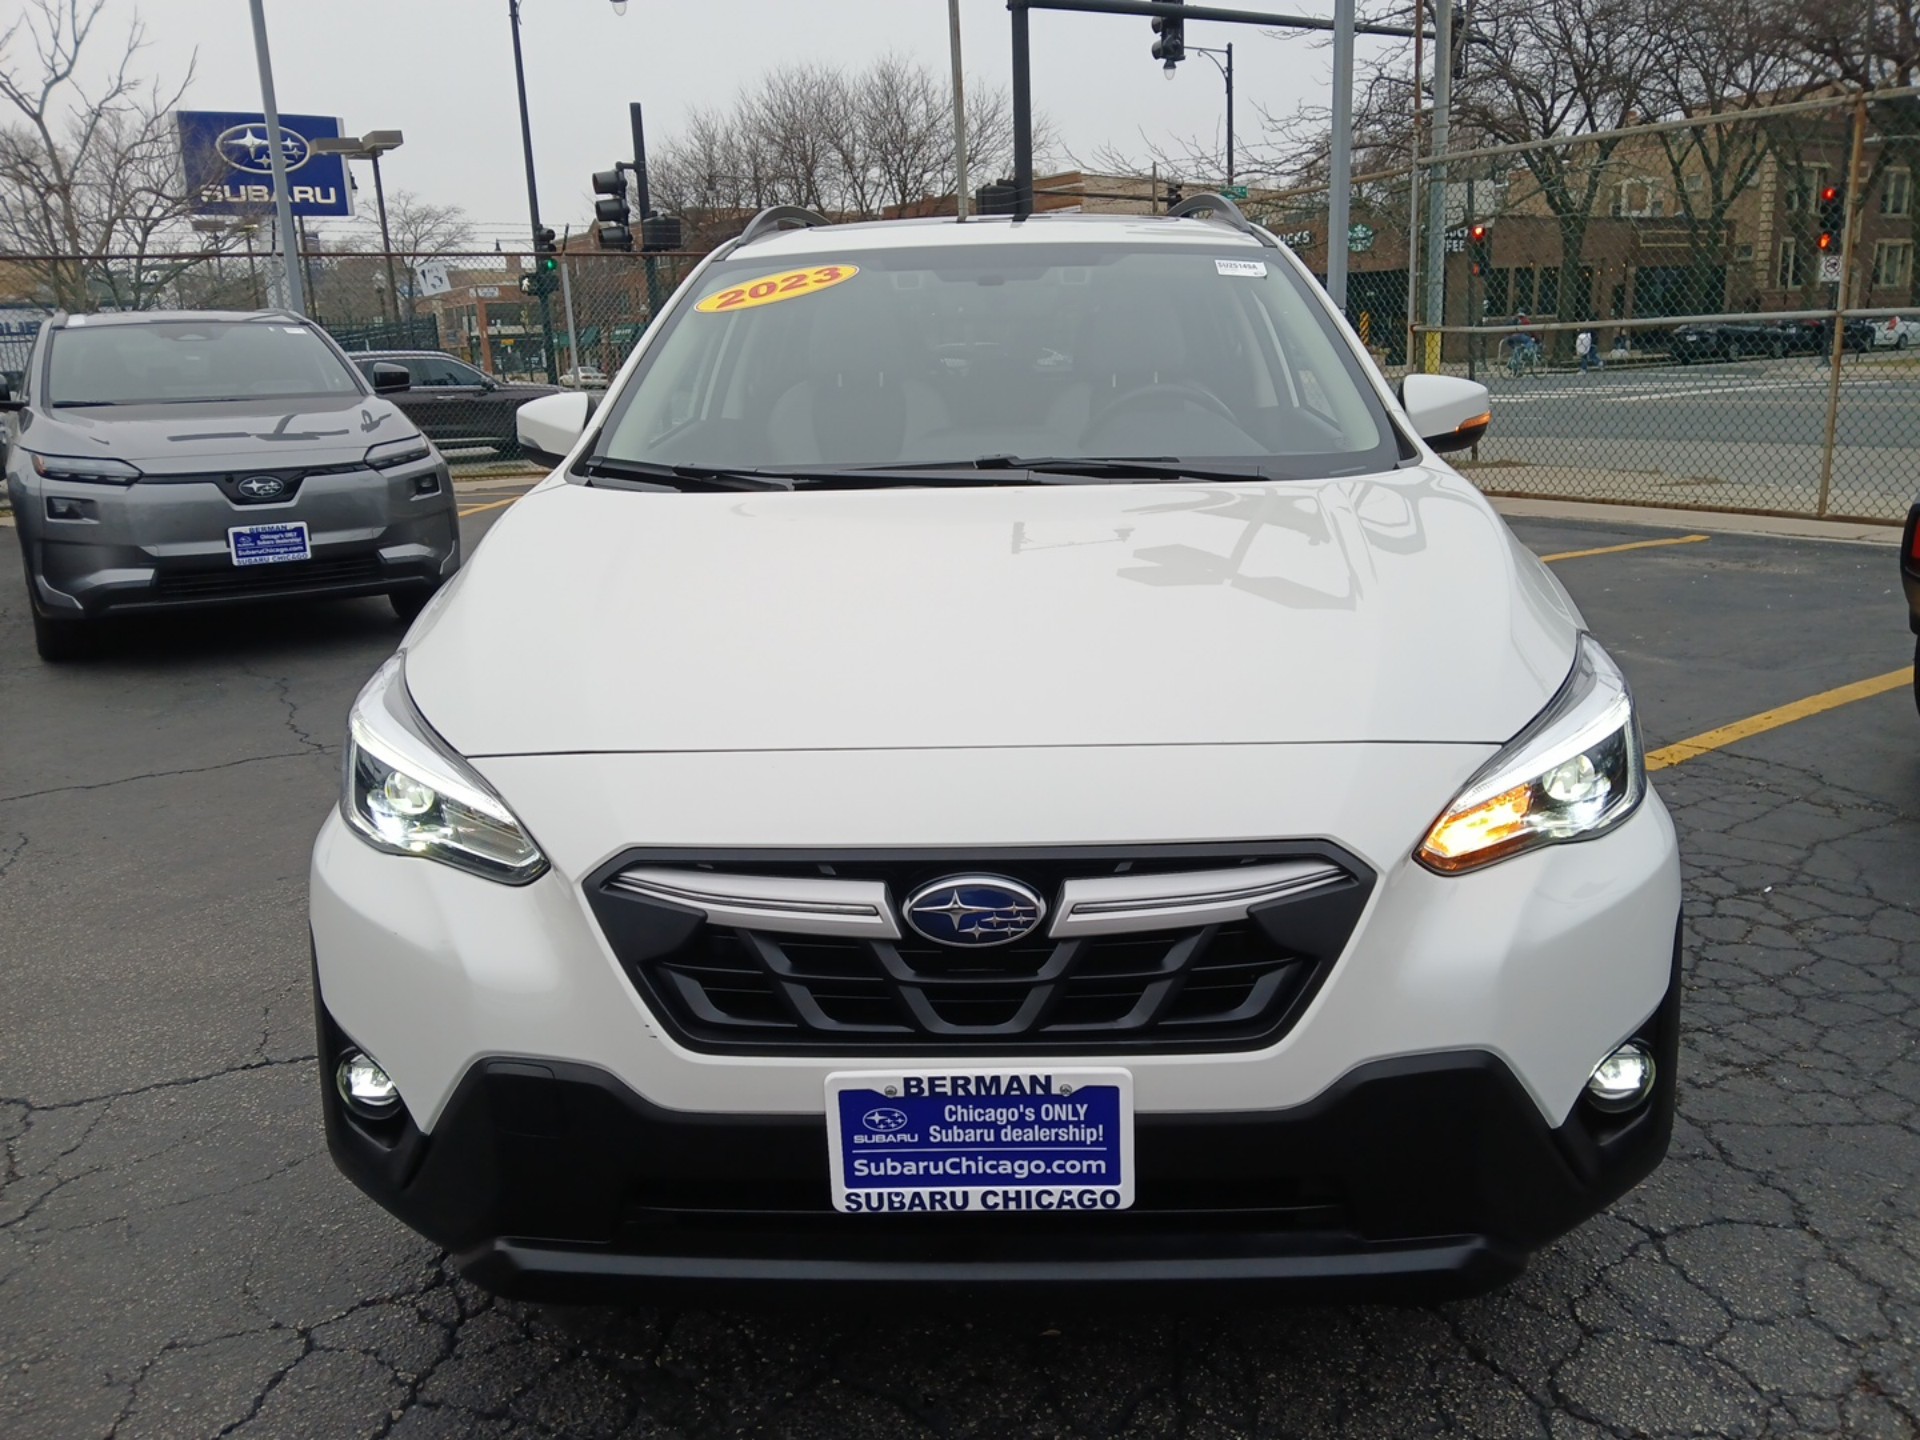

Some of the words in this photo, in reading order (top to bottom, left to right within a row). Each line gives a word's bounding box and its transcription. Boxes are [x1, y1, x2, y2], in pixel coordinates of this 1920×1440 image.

[201, 184, 336, 204] SUBRU
[716, 267, 842, 310] 2023
[249, 525, 288, 533] BERMAN
[236, 557, 270, 565] SUBARU
[271, 552, 309, 561] CHICAGO
[902, 1075, 1052, 1098] BERMAN
[944, 1103, 1035, 1125] Chicago's
[1041, 1103, 1088, 1121] ONLY
[853, 1133, 919, 1144] SUBARU
[929, 1124, 995, 1143] Subaru
[1000, 1124, 1104, 1145] dealership!
[853, 1155, 1107, 1179] SubaruChicago.com
[844, 1190, 969, 1212] SUBARU
[980, 1189, 1121, 1210] CHICAGO
